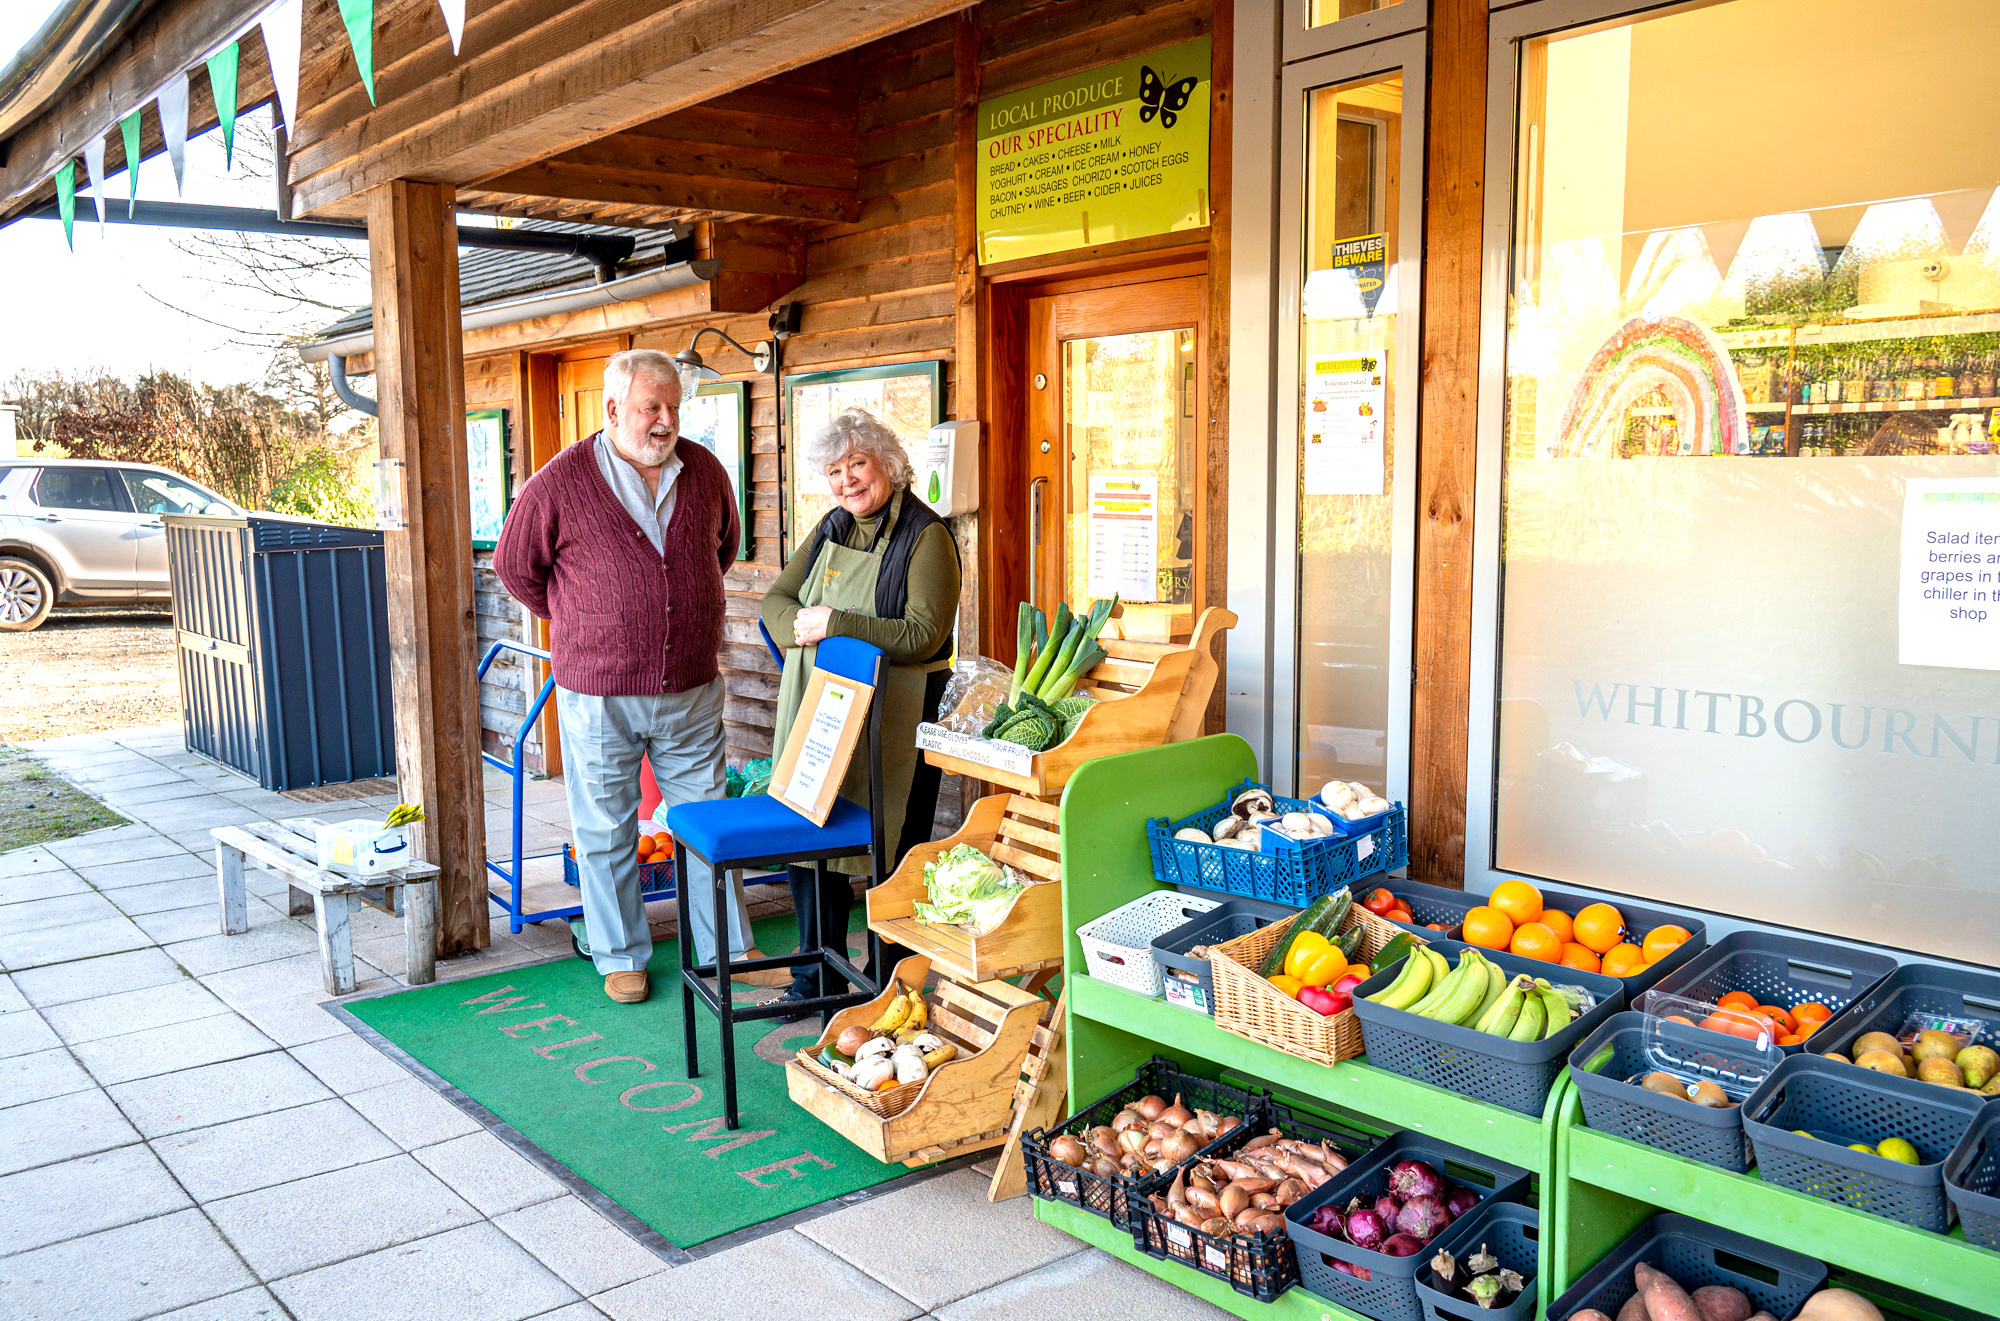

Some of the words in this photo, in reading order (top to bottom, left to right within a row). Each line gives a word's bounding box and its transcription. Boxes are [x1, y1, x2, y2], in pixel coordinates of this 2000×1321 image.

[990, 100, 1037, 130] LOCAL
[1043, 77, 1123, 115] PRODUCE
[990, 135, 1023, 158] OUR
[1028, 108, 1123, 149] SPECIALITY
[990, 162, 1015, 176] BREAD
[1023, 153, 1049, 168] CAKES
[1058, 142, 1091, 160] CHEESE
[1101, 135, 1121, 149] MILK
[990, 173, 1027, 190] YOGHURT
[1035, 165, 1064, 181] CREAM
[1073, 159, 1087, 171] ICE
[1088, 152, 1119, 168] CREAM
[1129, 141, 1162, 158] HONEY
[990, 191, 1016, 205] BACON
[1025, 178, 1068, 197] SAUSAGES
[1073, 169, 1111, 187] CHORIZO
[1121, 160, 1159, 176] SCOTCH
[1162, 152, 1189, 168] EGGS
[990, 205, 1026, 219] CHUTNEY
[1035, 197, 1054, 210] WINE
[1064, 191, 1085, 204] BEER
[1094, 182, 1120, 198] CIDER
[1130, 174, 1162, 190] JUICES
[1335, 249, 1382, 267] BEWARE
[1336, 238, 1381, 256] THIEVES
[1926, 531, 1969, 544] Salad
[1929, 550, 1981, 563] berries
[1921, 570, 1973, 584] grapes
[1979, 570, 1991, 582] in
[1924, 587, 1968, 600] chiller
[1974, 588, 1986, 601] in
[1950, 607, 1987, 622] shop
[1570, 679, 2000, 765] WHITBOURN
[459, 985, 836, 1188] WELCOME
